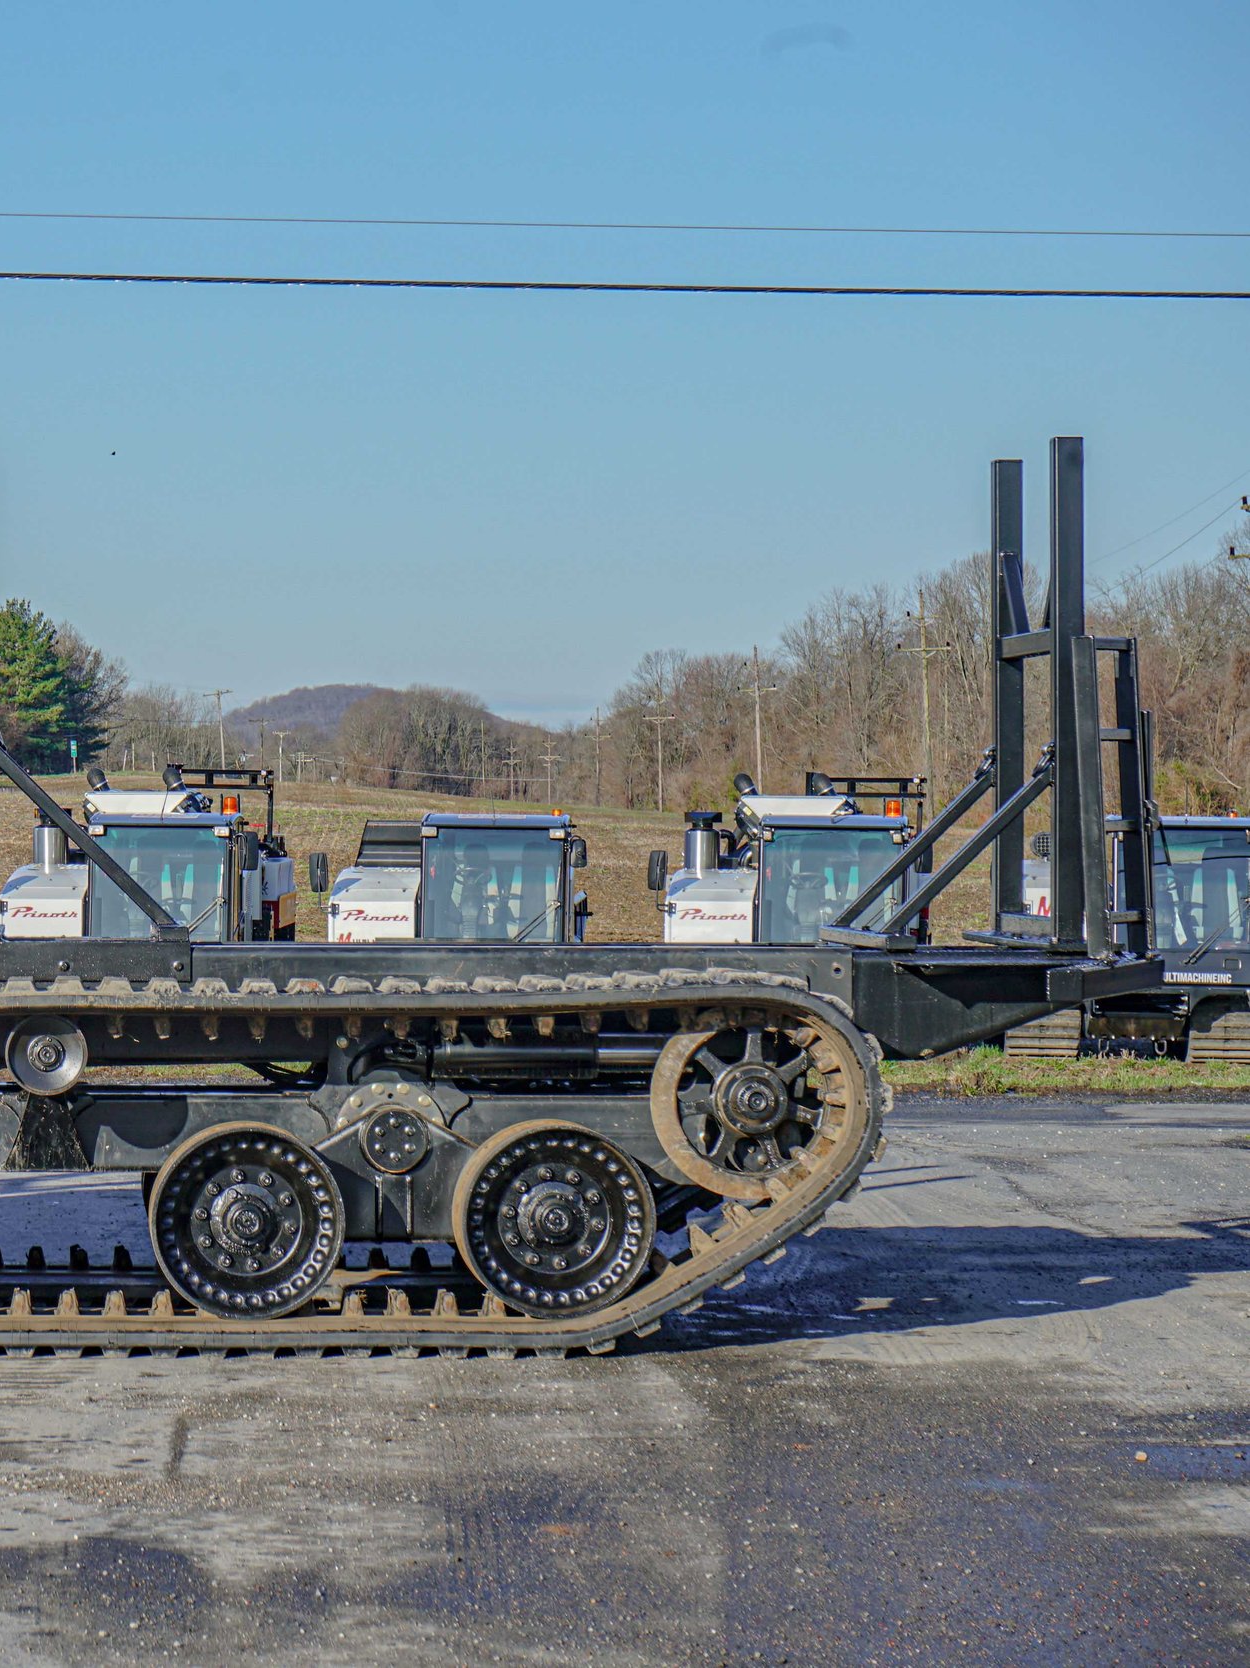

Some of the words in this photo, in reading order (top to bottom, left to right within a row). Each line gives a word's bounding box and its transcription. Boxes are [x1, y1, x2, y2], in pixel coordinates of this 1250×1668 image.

[9, 906, 78, 918] Prinoth
[341, 909, 409, 921] Prinoth
[677, 908, 748, 920] Prinoth
